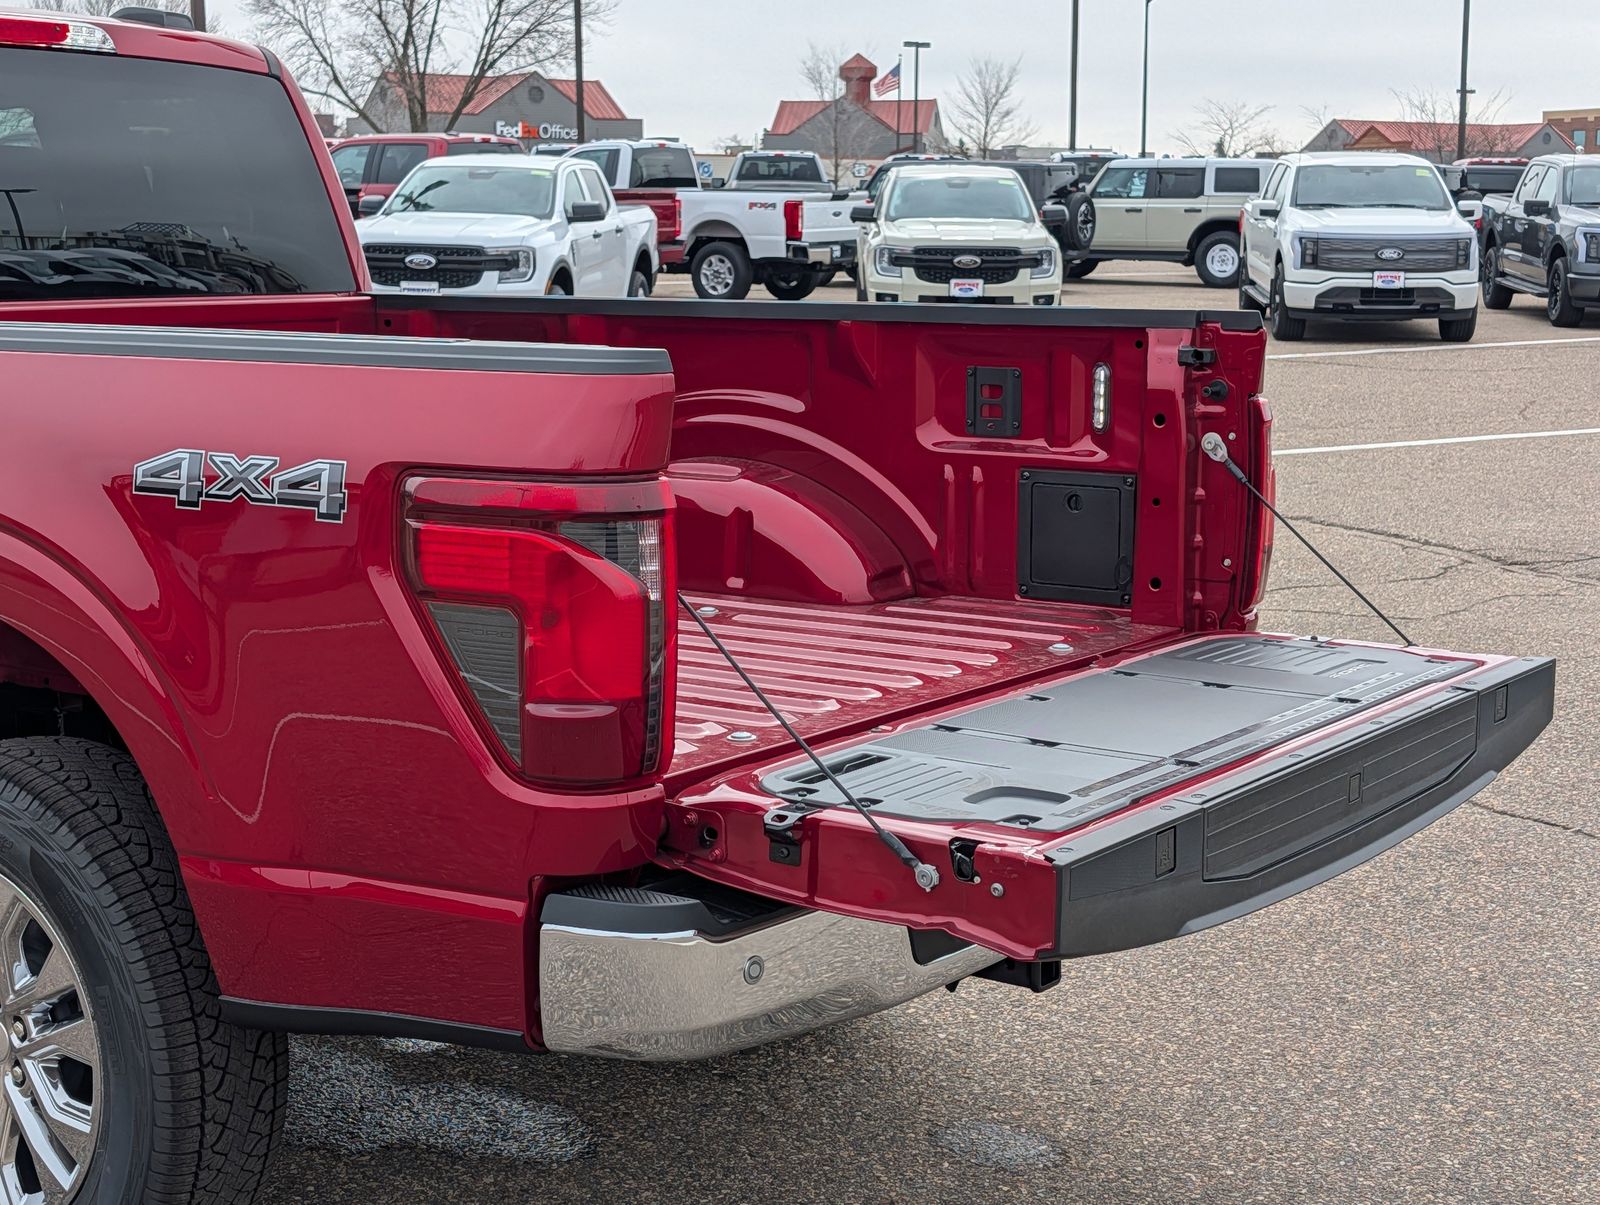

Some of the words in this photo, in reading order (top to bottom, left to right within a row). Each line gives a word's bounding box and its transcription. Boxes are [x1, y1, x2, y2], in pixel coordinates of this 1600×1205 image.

[496, 120, 539, 139] FedEx
[539, 122, 579, 140] Office
[748, 202, 777, 210] FX4
[457, 626, 514, 639] FORD
